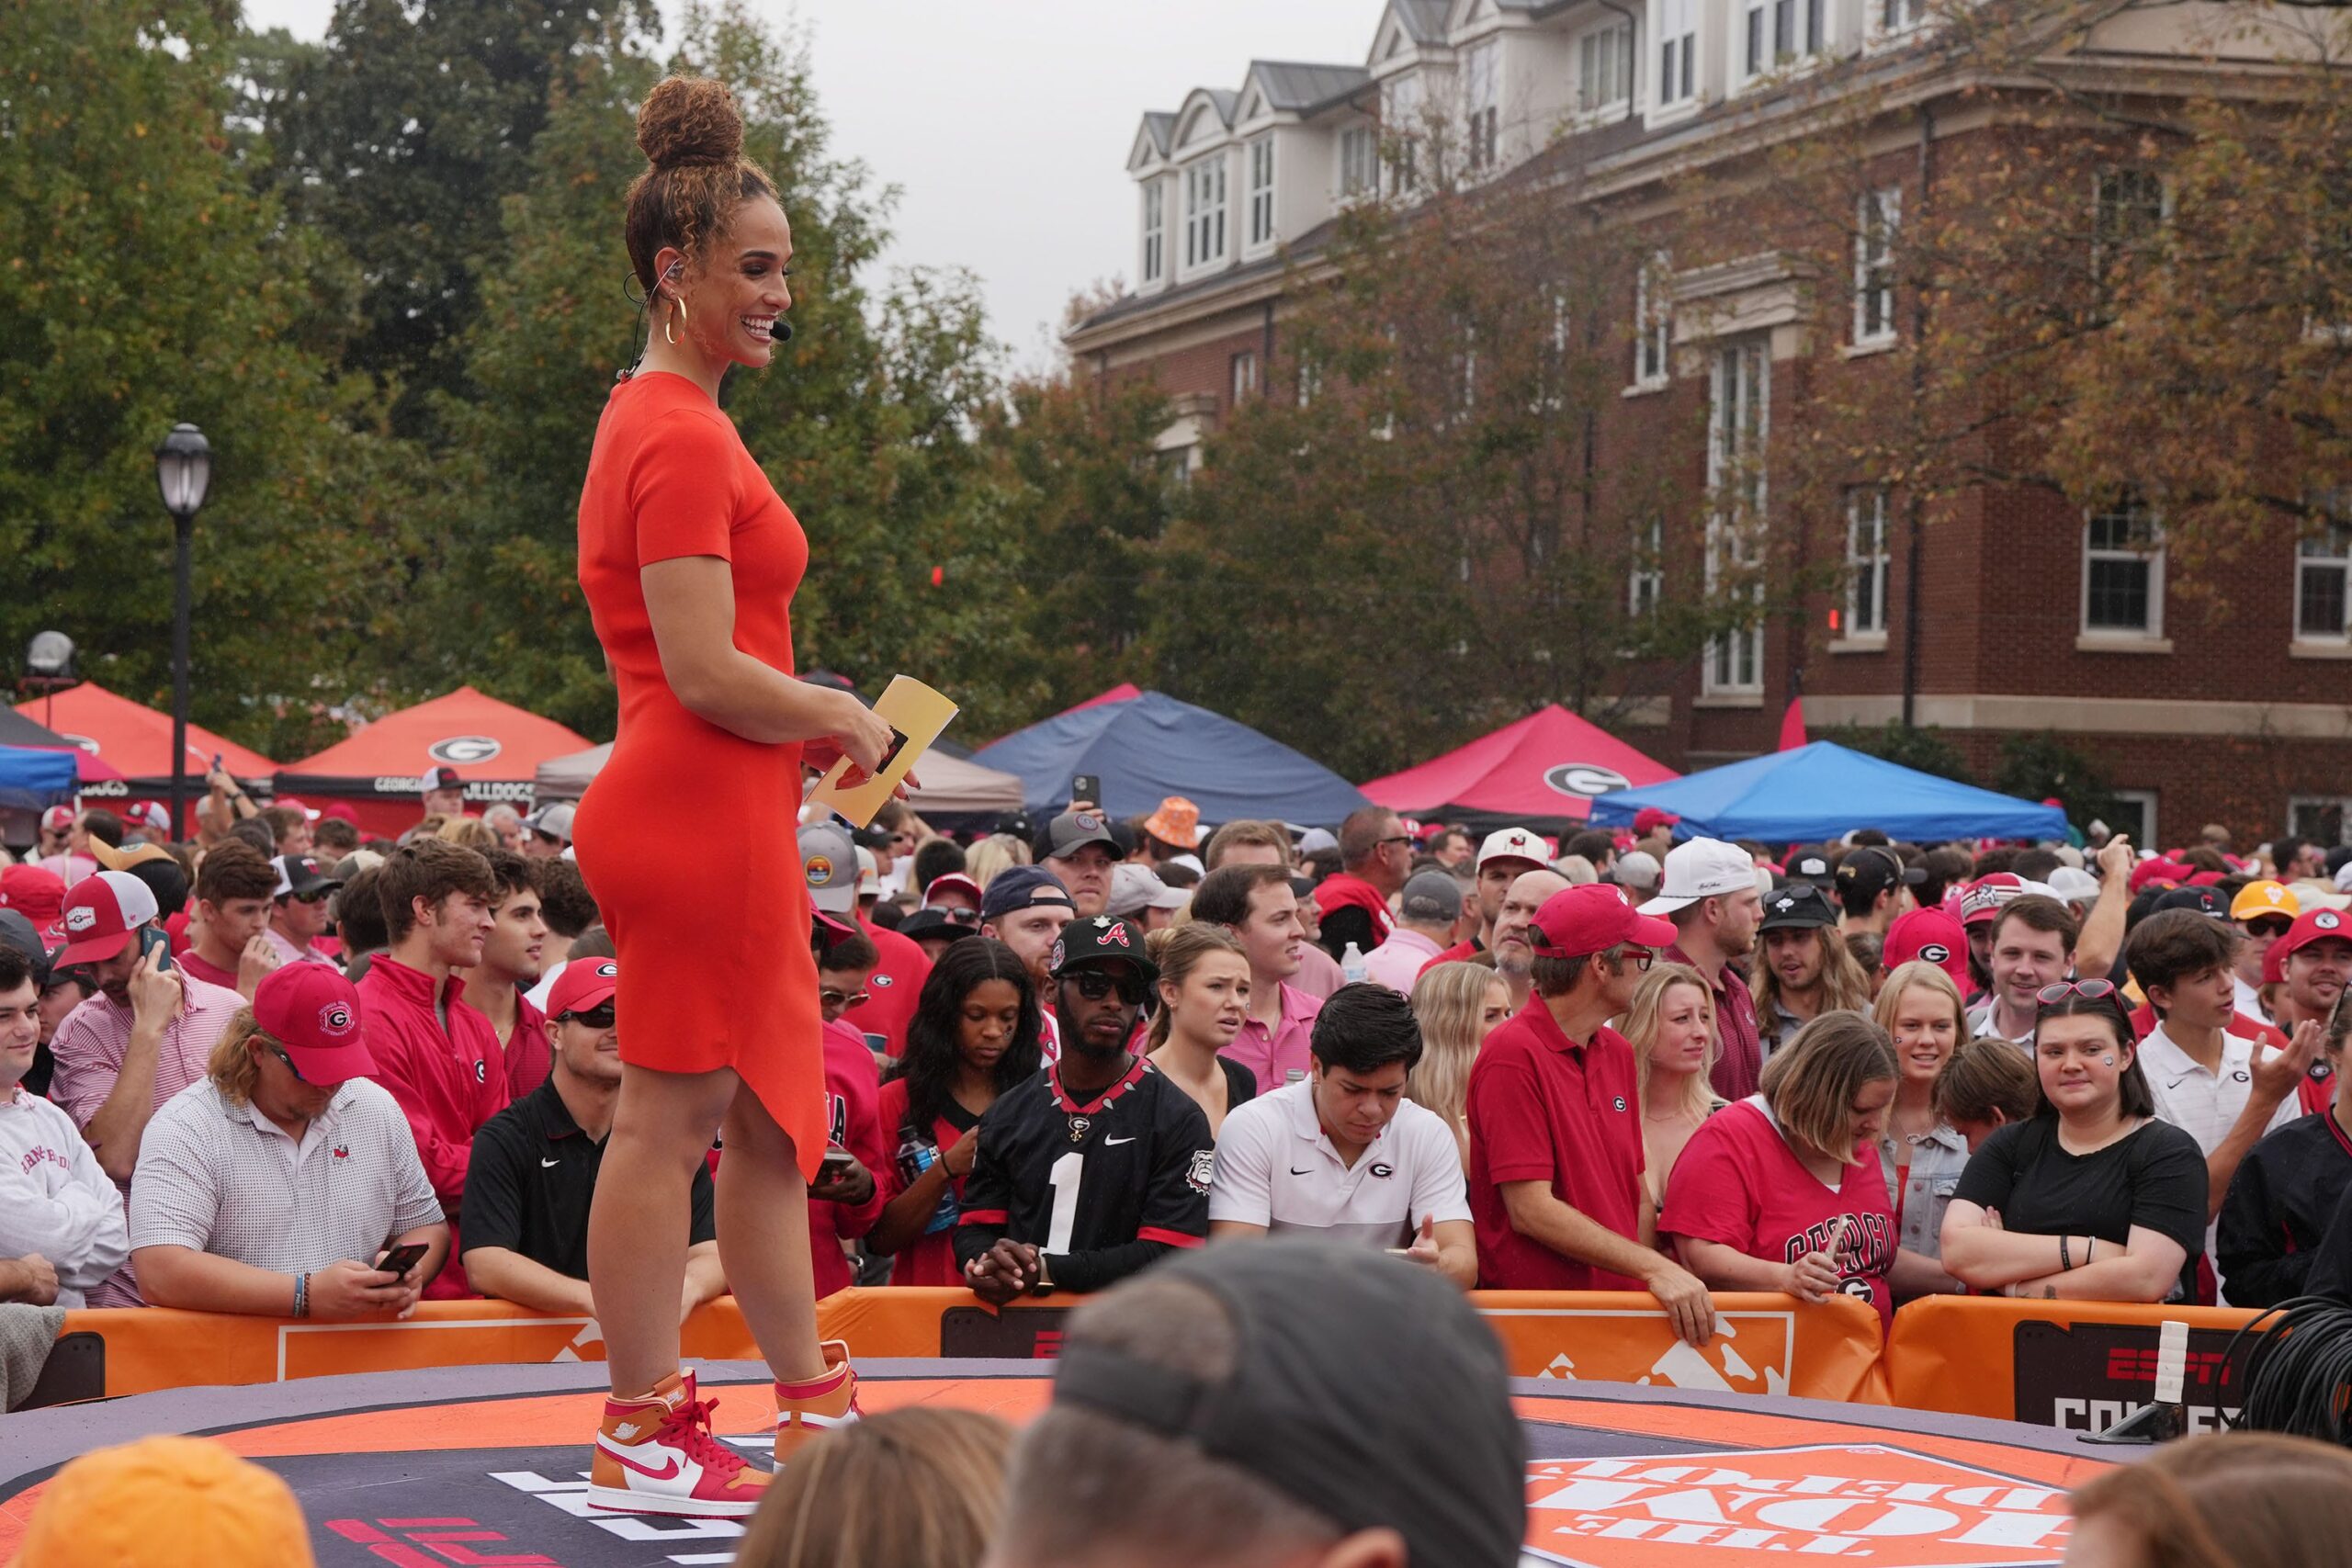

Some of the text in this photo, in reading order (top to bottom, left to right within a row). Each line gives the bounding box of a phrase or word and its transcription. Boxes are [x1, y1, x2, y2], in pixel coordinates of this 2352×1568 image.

[428, 736, 502, 764] G
[374, 777, 535, 801] GEORGI ULLDOGS
[1544, 762, 1632, 800] G
[1097, 922, 1130, 947] A
[1917, 943, 1950, 964] G
[872, 974, 893, 987] G
[329, 1010, 348, 1027] G
[2232, 1071, 2250, 1083] G
[1612, 1096, 1626, 1112] G
[1069, 1117, 1091, 1131] G
[1368, 1162, 1395, 1179] G
[1039, 1151, 1084, 1255] 1
[1542, 1460, 2057, 1511] DEPOT
